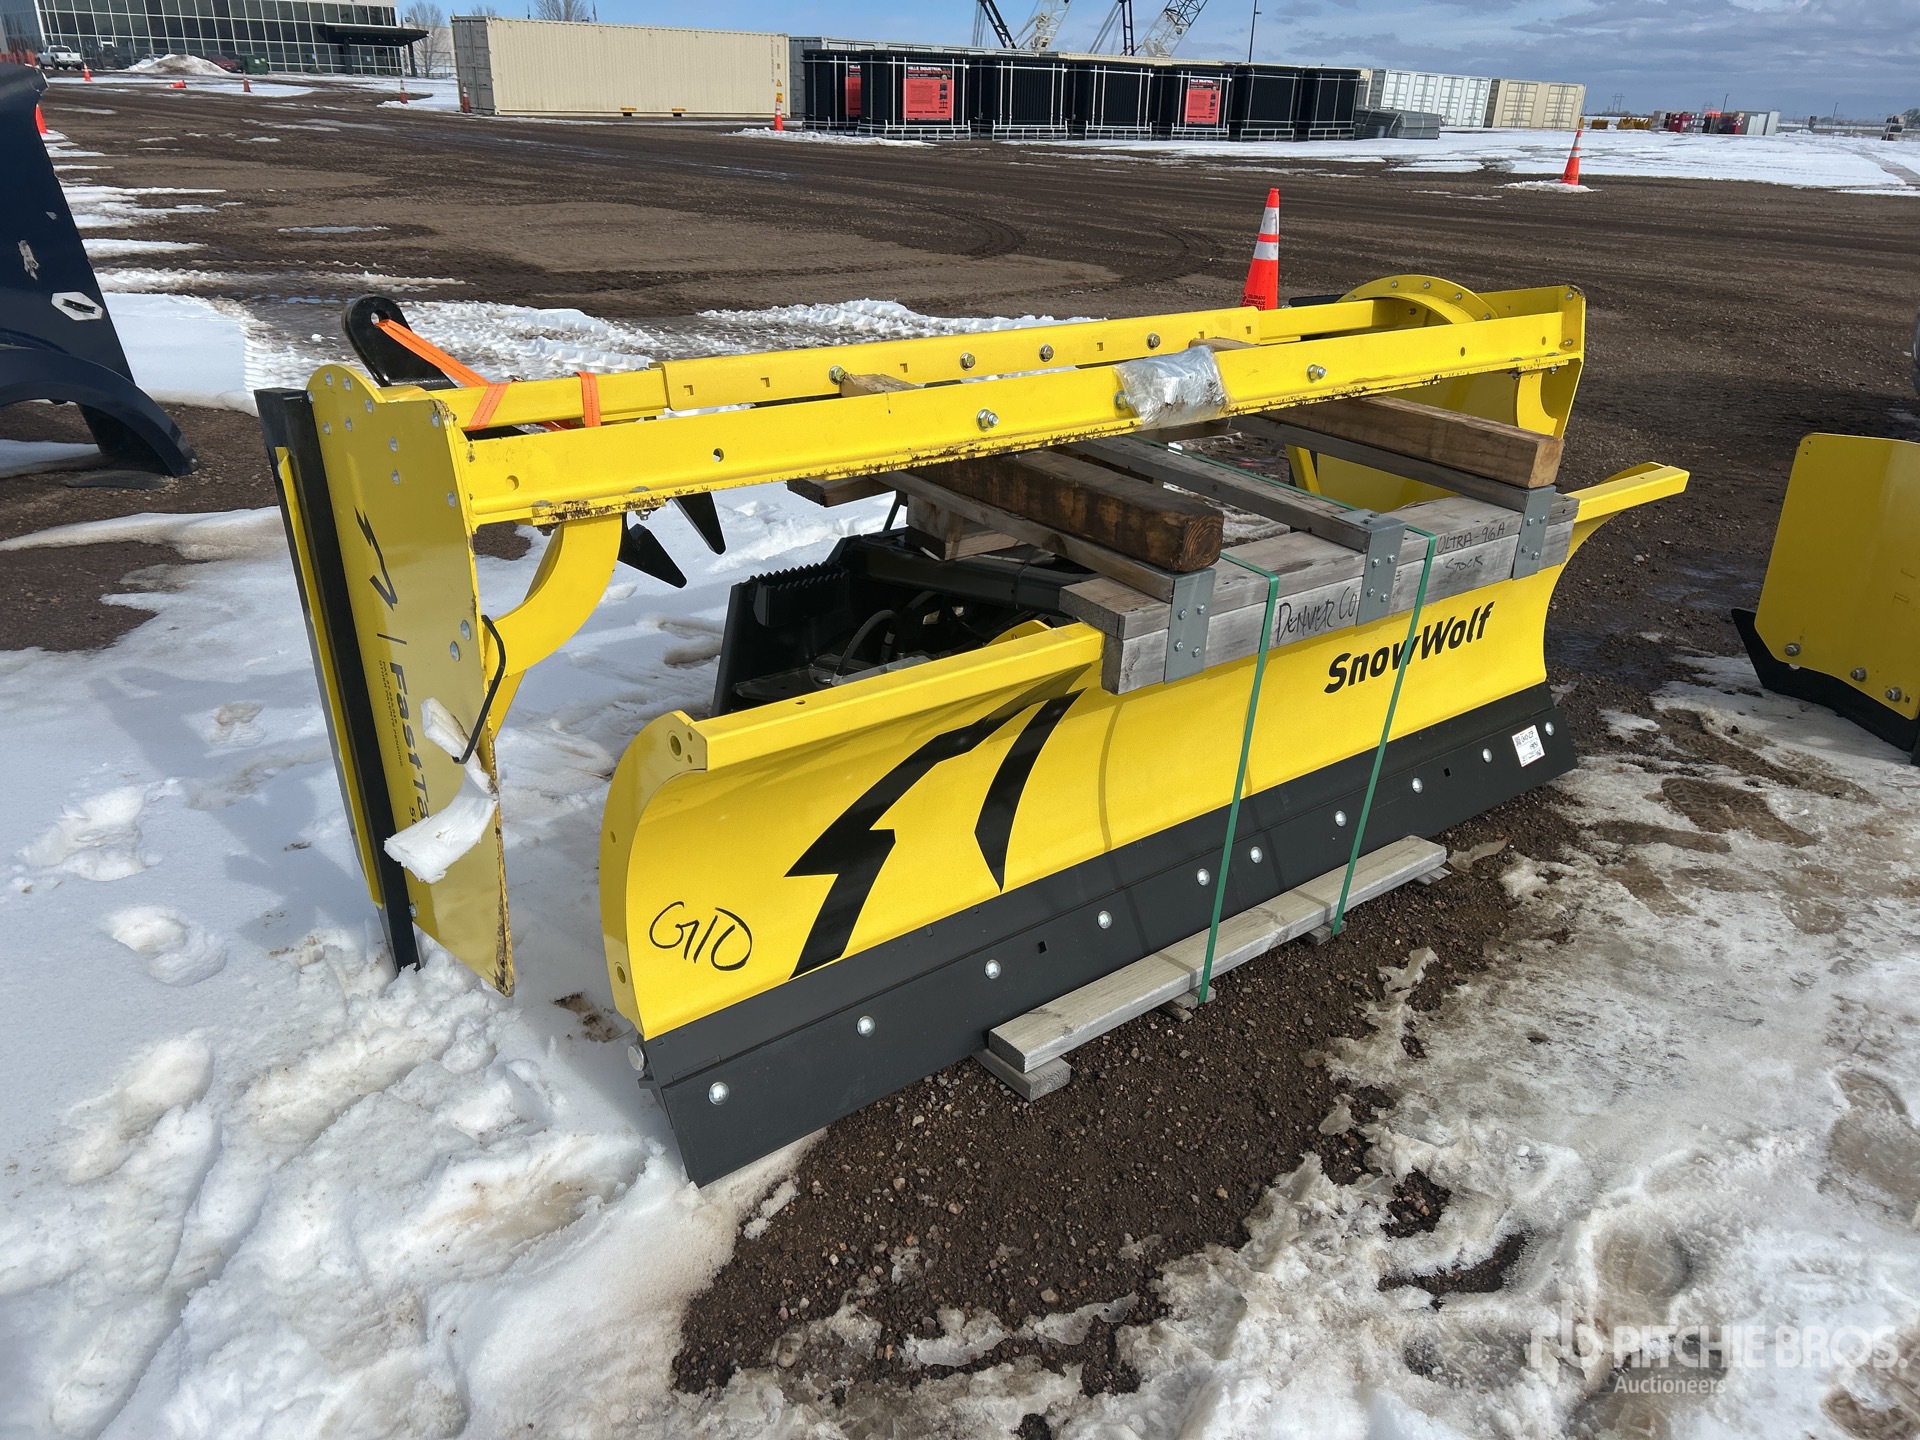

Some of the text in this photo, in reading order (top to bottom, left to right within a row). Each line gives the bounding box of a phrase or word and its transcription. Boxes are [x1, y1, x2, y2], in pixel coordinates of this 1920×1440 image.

[1445, 555, 1483, 576] STOCK
[1324, 601, 1495, 694] SnowWolf
[389, 662, 430, 819] FastTa
